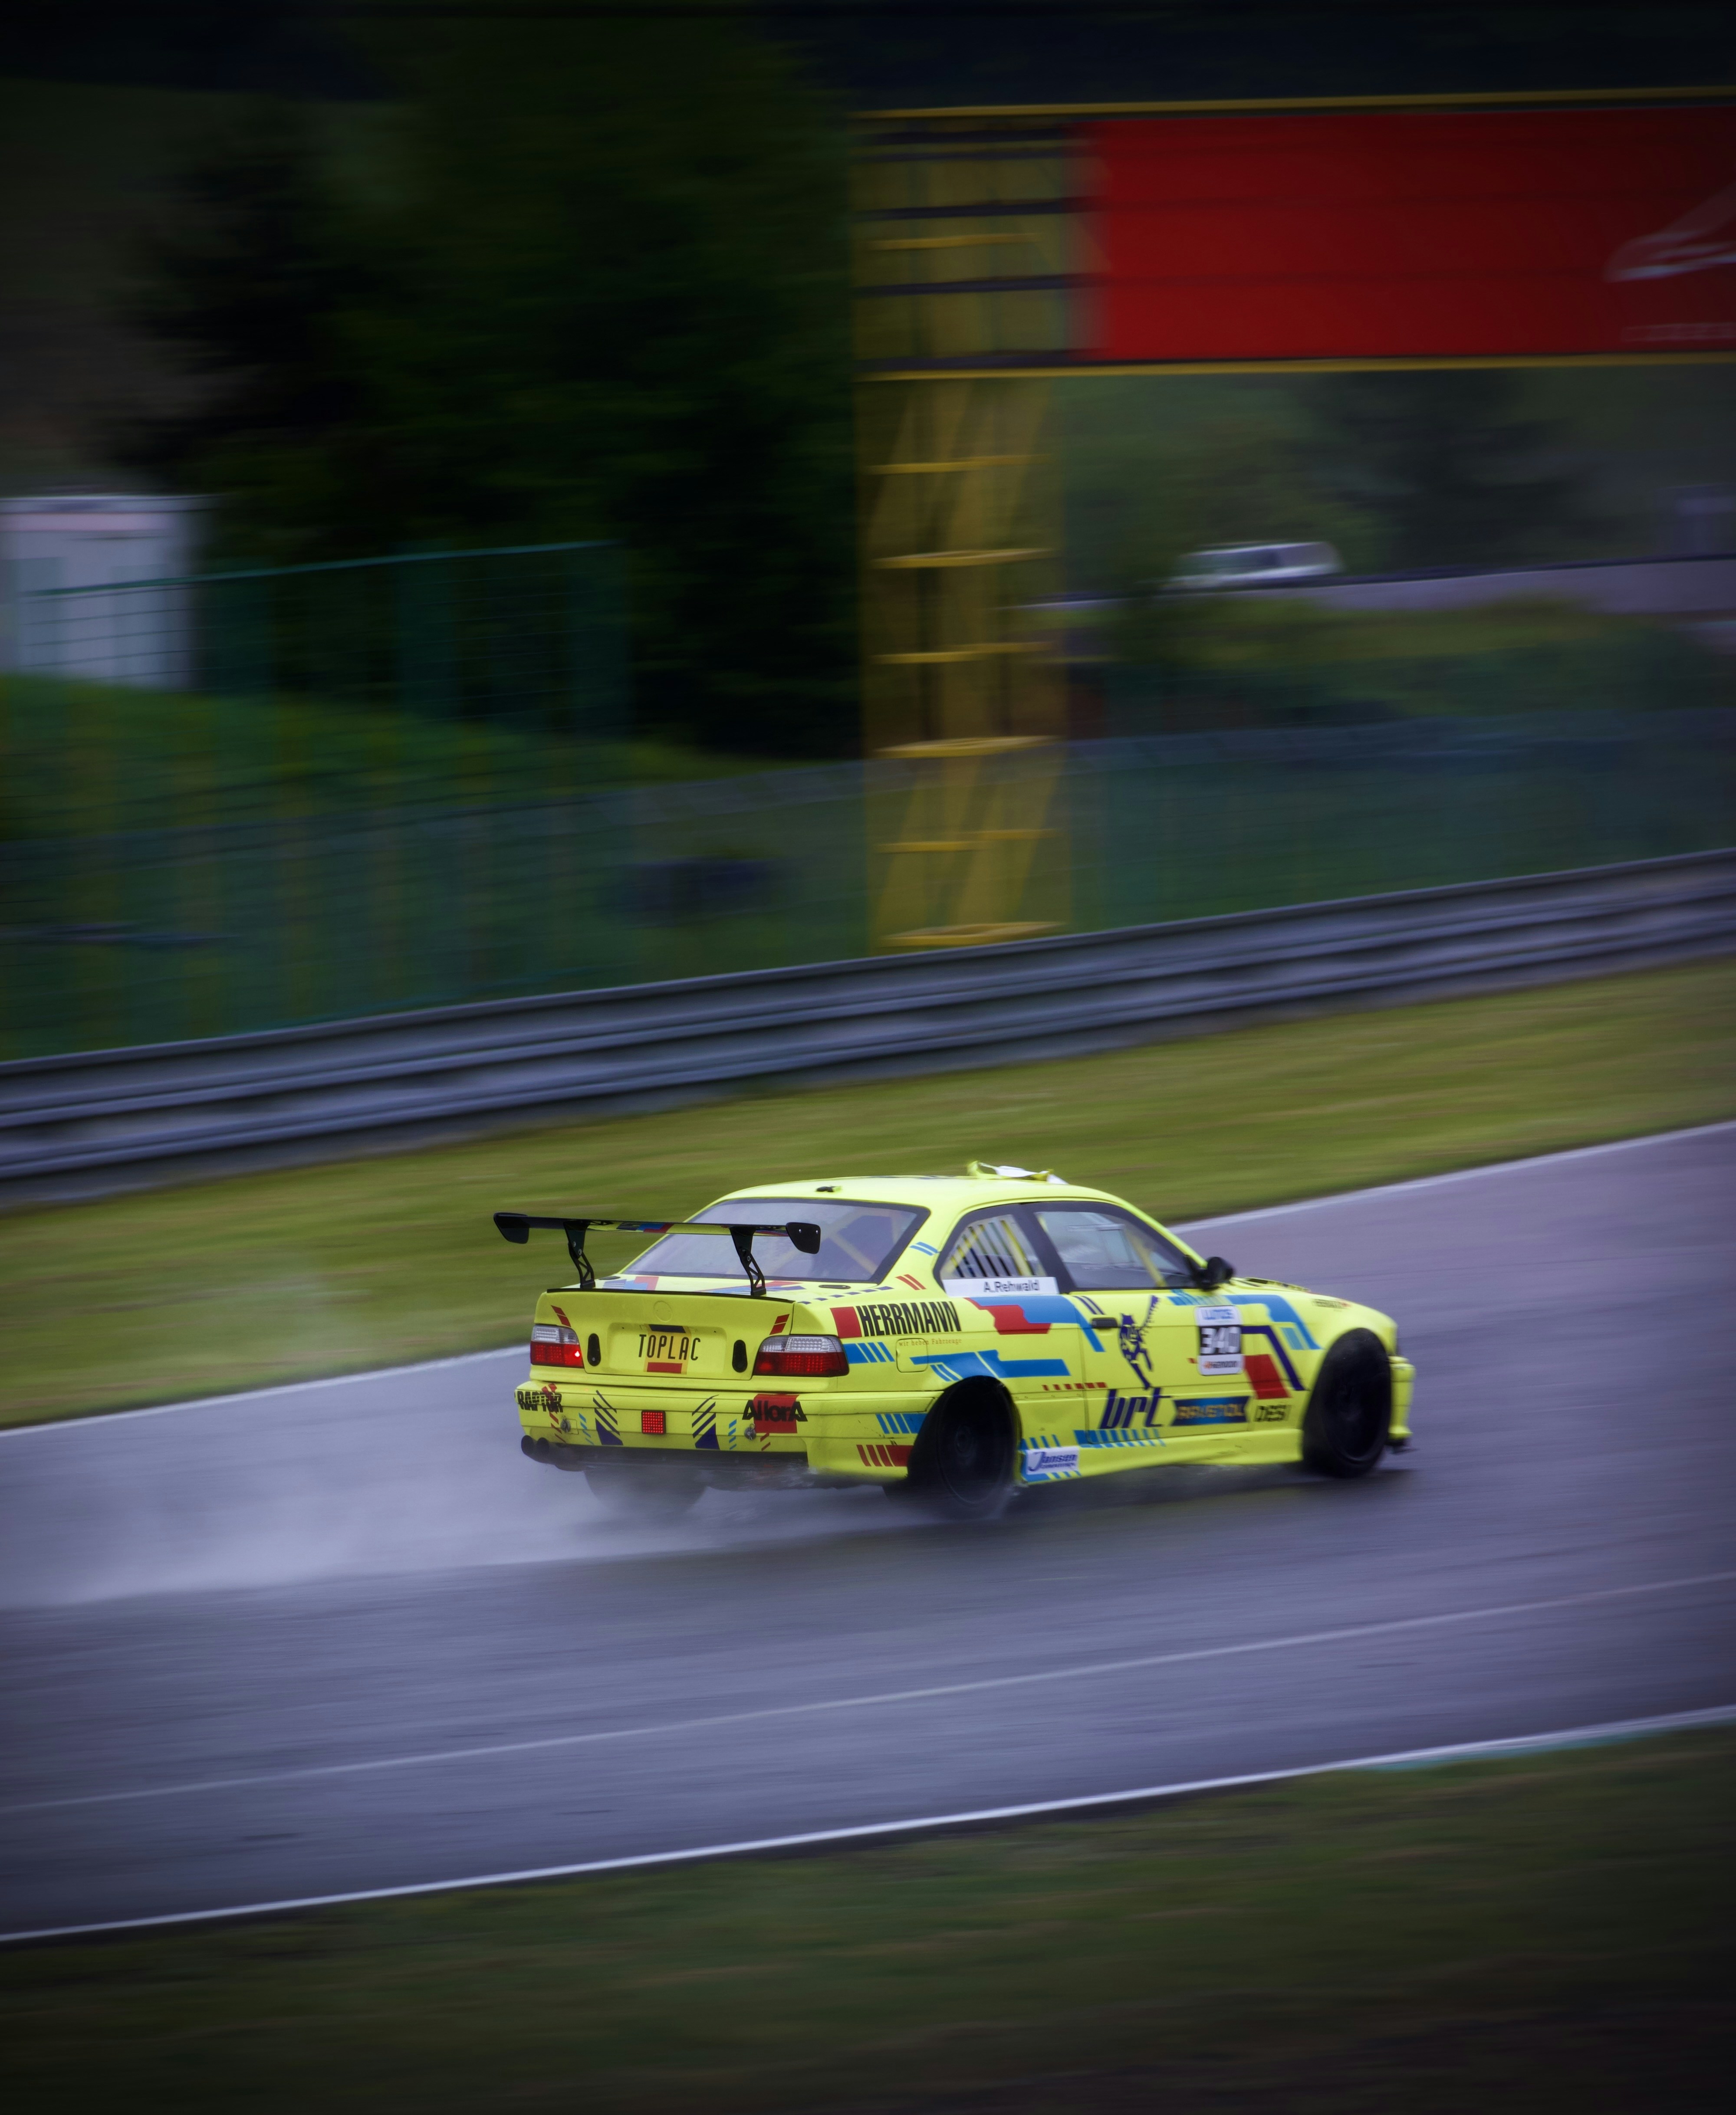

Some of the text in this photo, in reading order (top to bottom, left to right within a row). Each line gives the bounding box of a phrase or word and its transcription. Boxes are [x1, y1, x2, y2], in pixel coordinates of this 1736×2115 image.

[855, 1301, 962, 1337] HERRMANN
[638, 1334, 701, 1361] TOPLAC
[1200, 1327, 1242, 1354] 340
